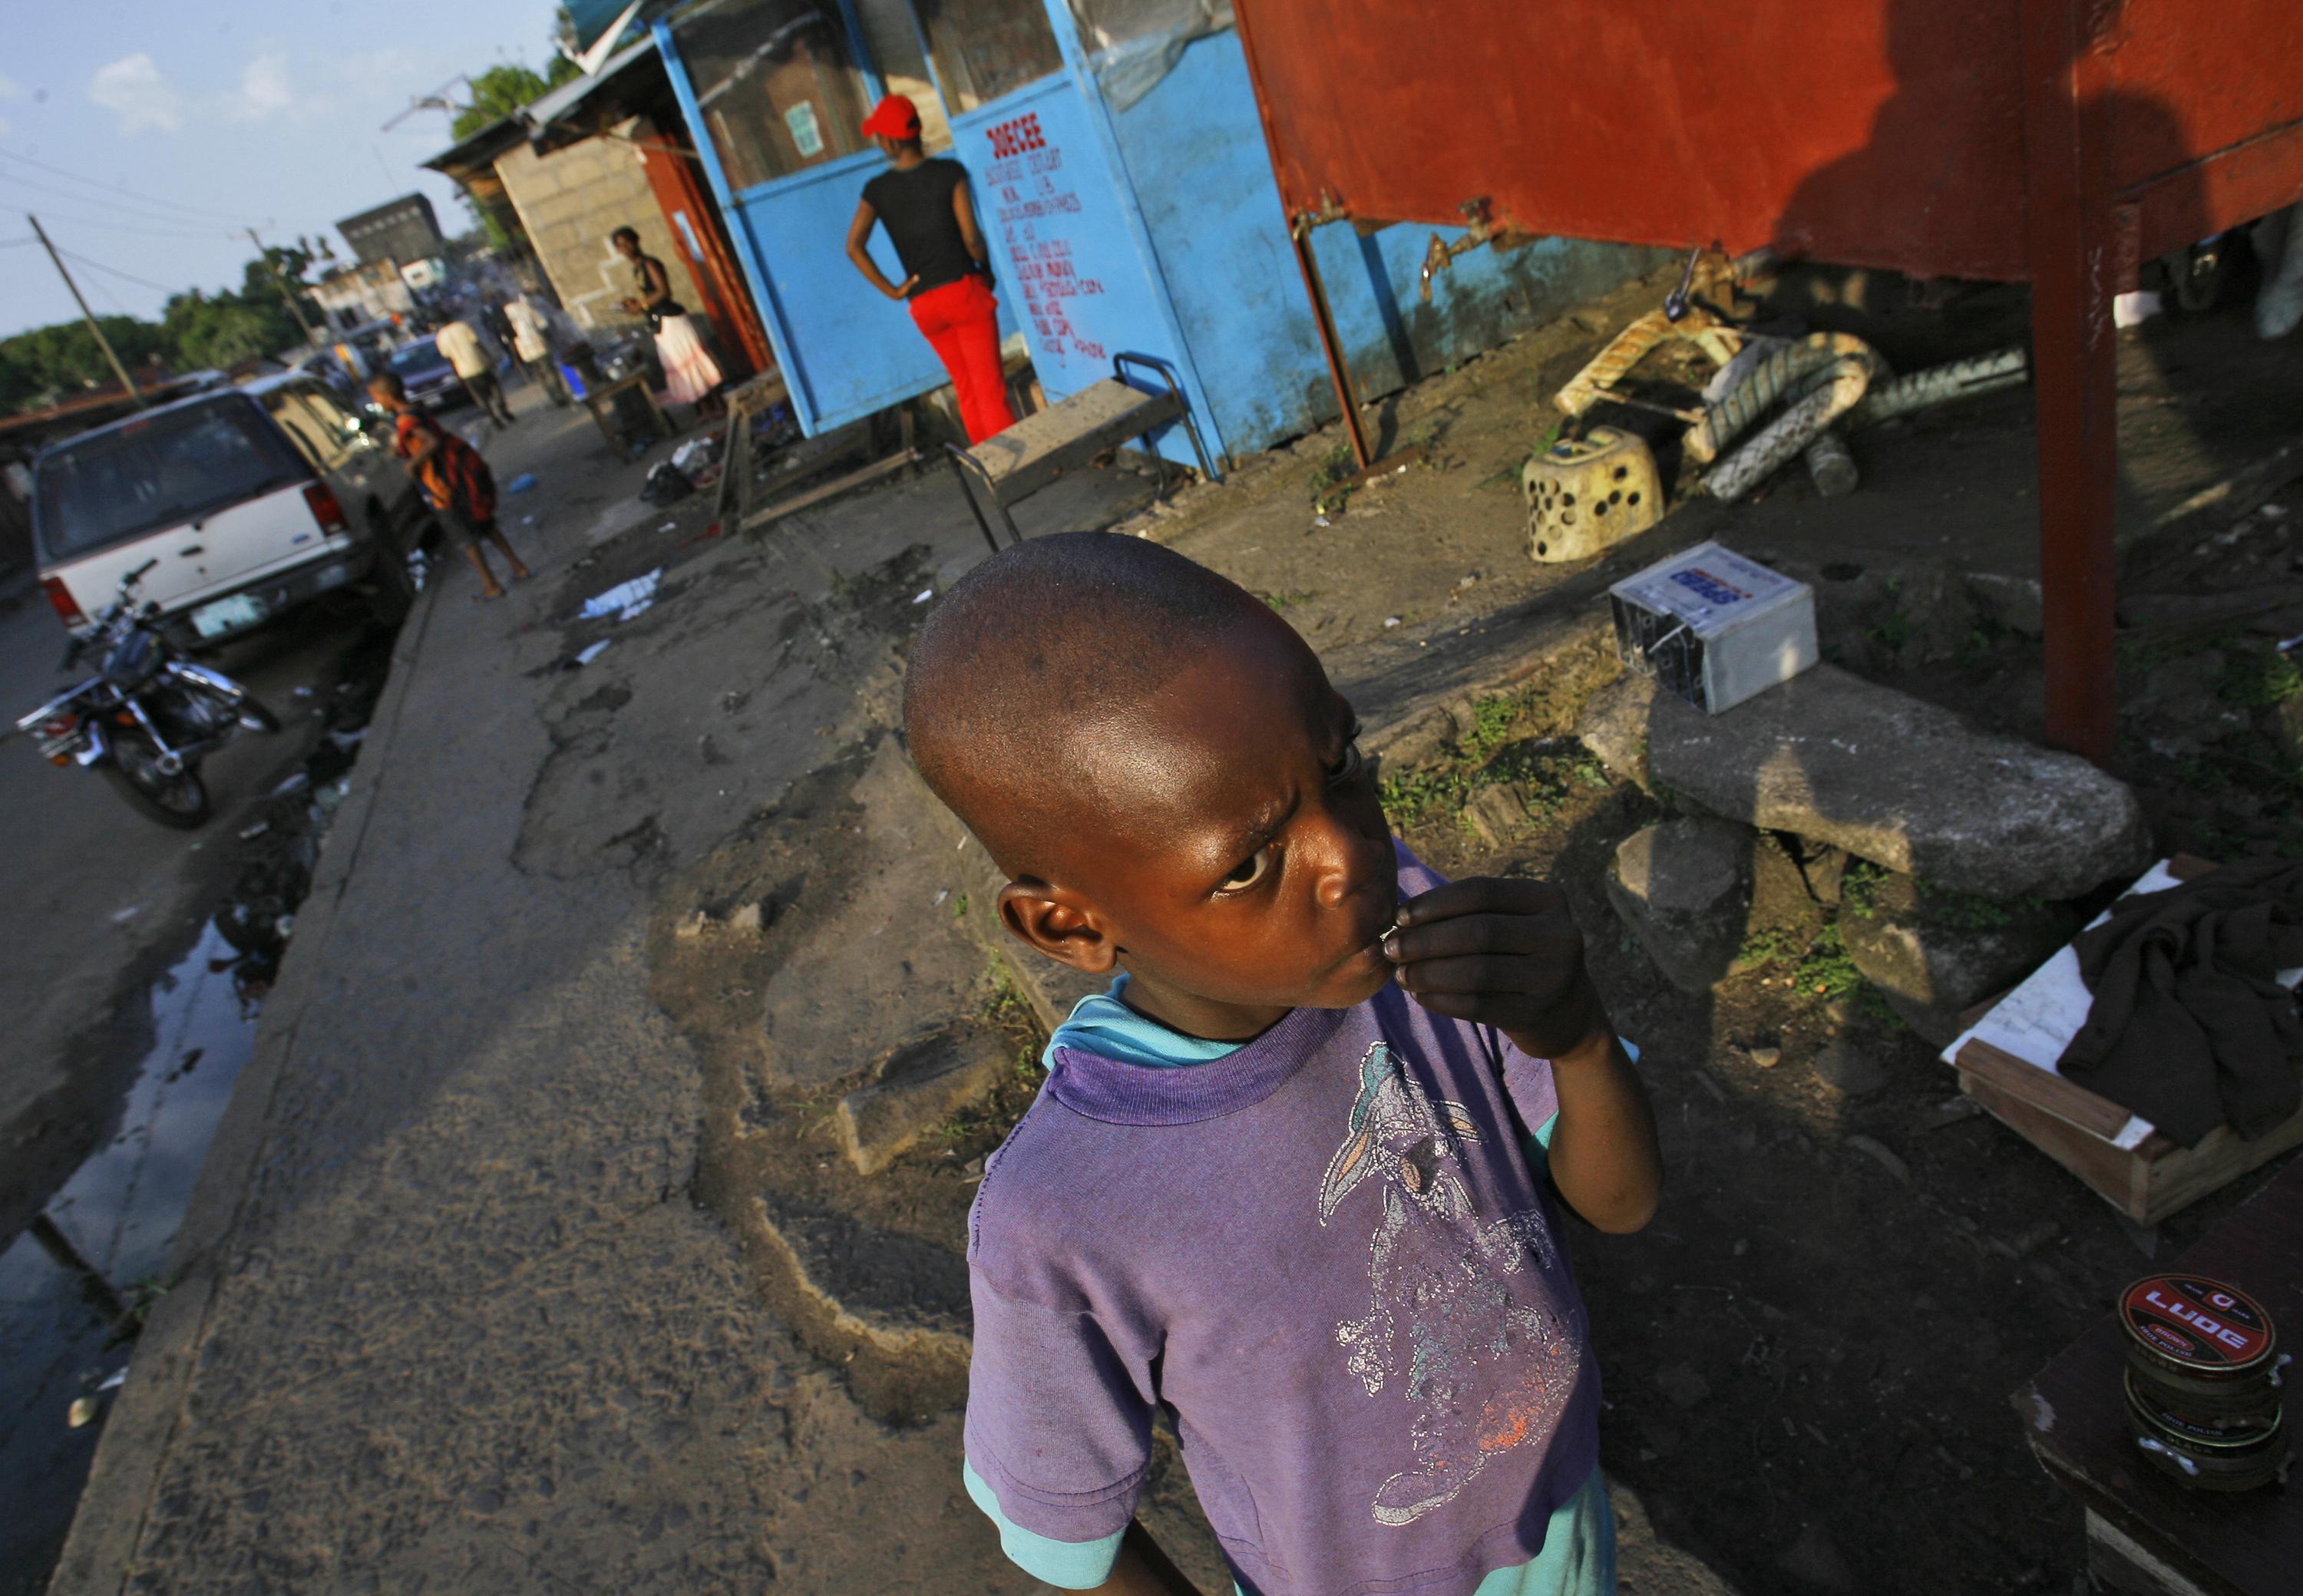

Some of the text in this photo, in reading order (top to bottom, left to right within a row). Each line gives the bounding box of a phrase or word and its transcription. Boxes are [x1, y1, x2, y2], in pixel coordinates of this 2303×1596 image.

[2146, 1290, 2248, 1350] LUDE
[2155, 1327, 2187, 1347] BROWN
[2159, 1340, 2193, 1357] POLISH
[2187, 1424, 2223, 1436] POLISH
